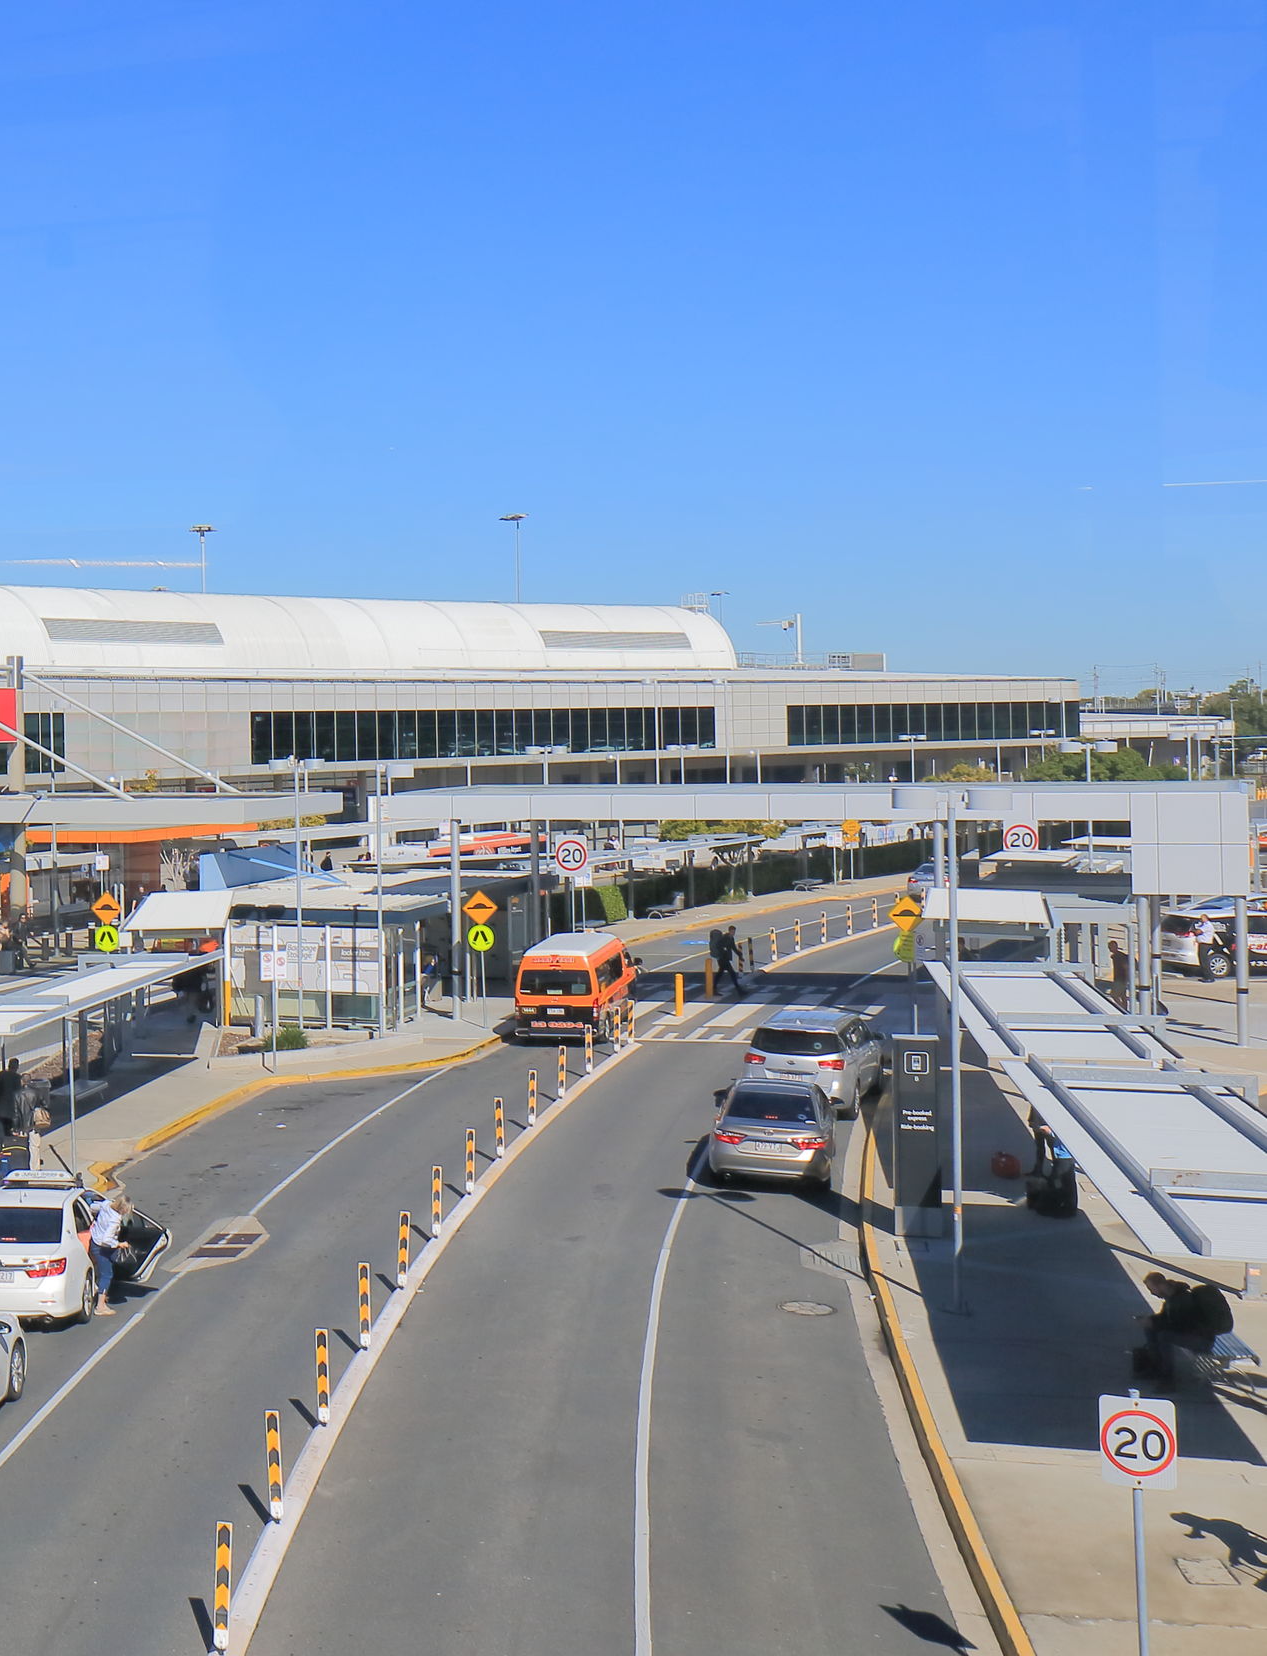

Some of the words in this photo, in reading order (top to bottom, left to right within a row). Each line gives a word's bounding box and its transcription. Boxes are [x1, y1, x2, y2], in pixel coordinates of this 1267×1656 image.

[1010, 832, 1034, 848] 20
[561, 848, 583, 864] 20
[287, 943, 317, 952] Bagage
[1114, 1427, 1166, 1461] 20
